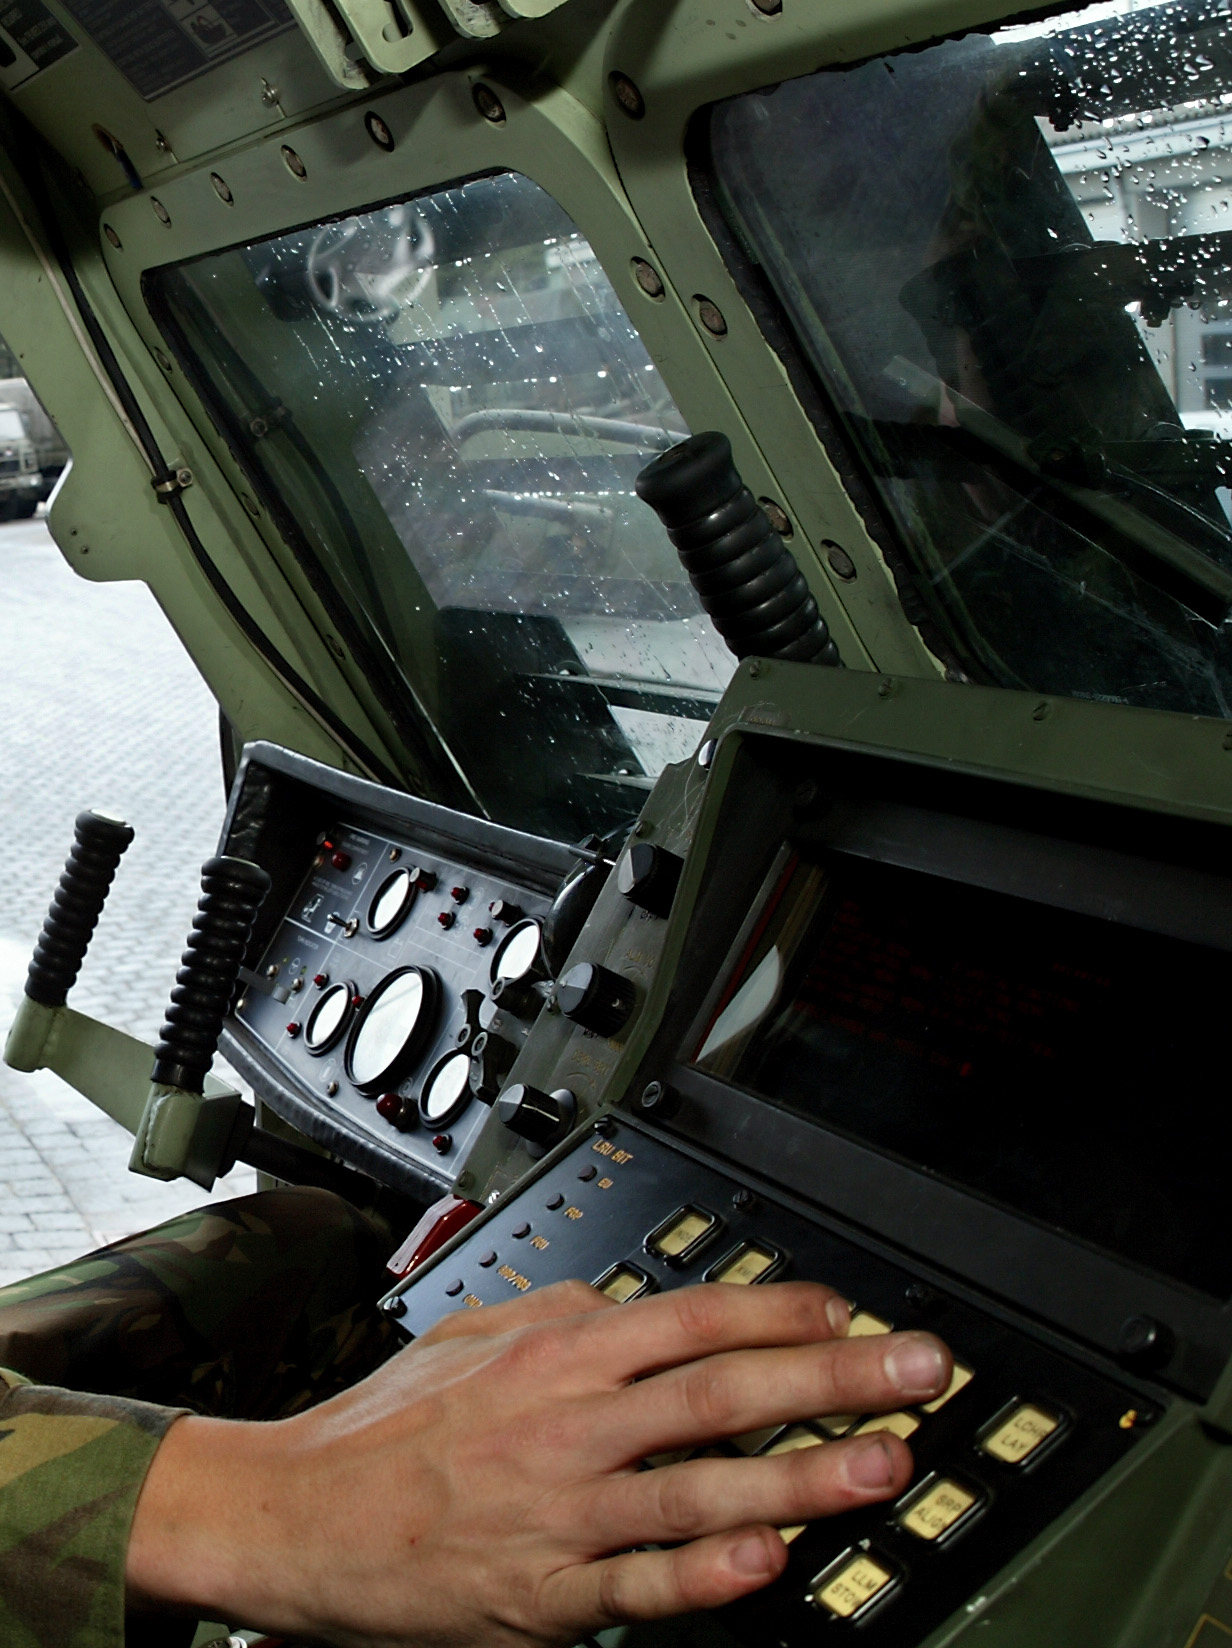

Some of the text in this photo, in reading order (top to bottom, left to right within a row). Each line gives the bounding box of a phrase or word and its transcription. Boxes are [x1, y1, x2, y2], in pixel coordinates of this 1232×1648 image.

[592, 1139, 633, 1165] LRU BIT
[1001, 1433, 1028, 1451] LAY
